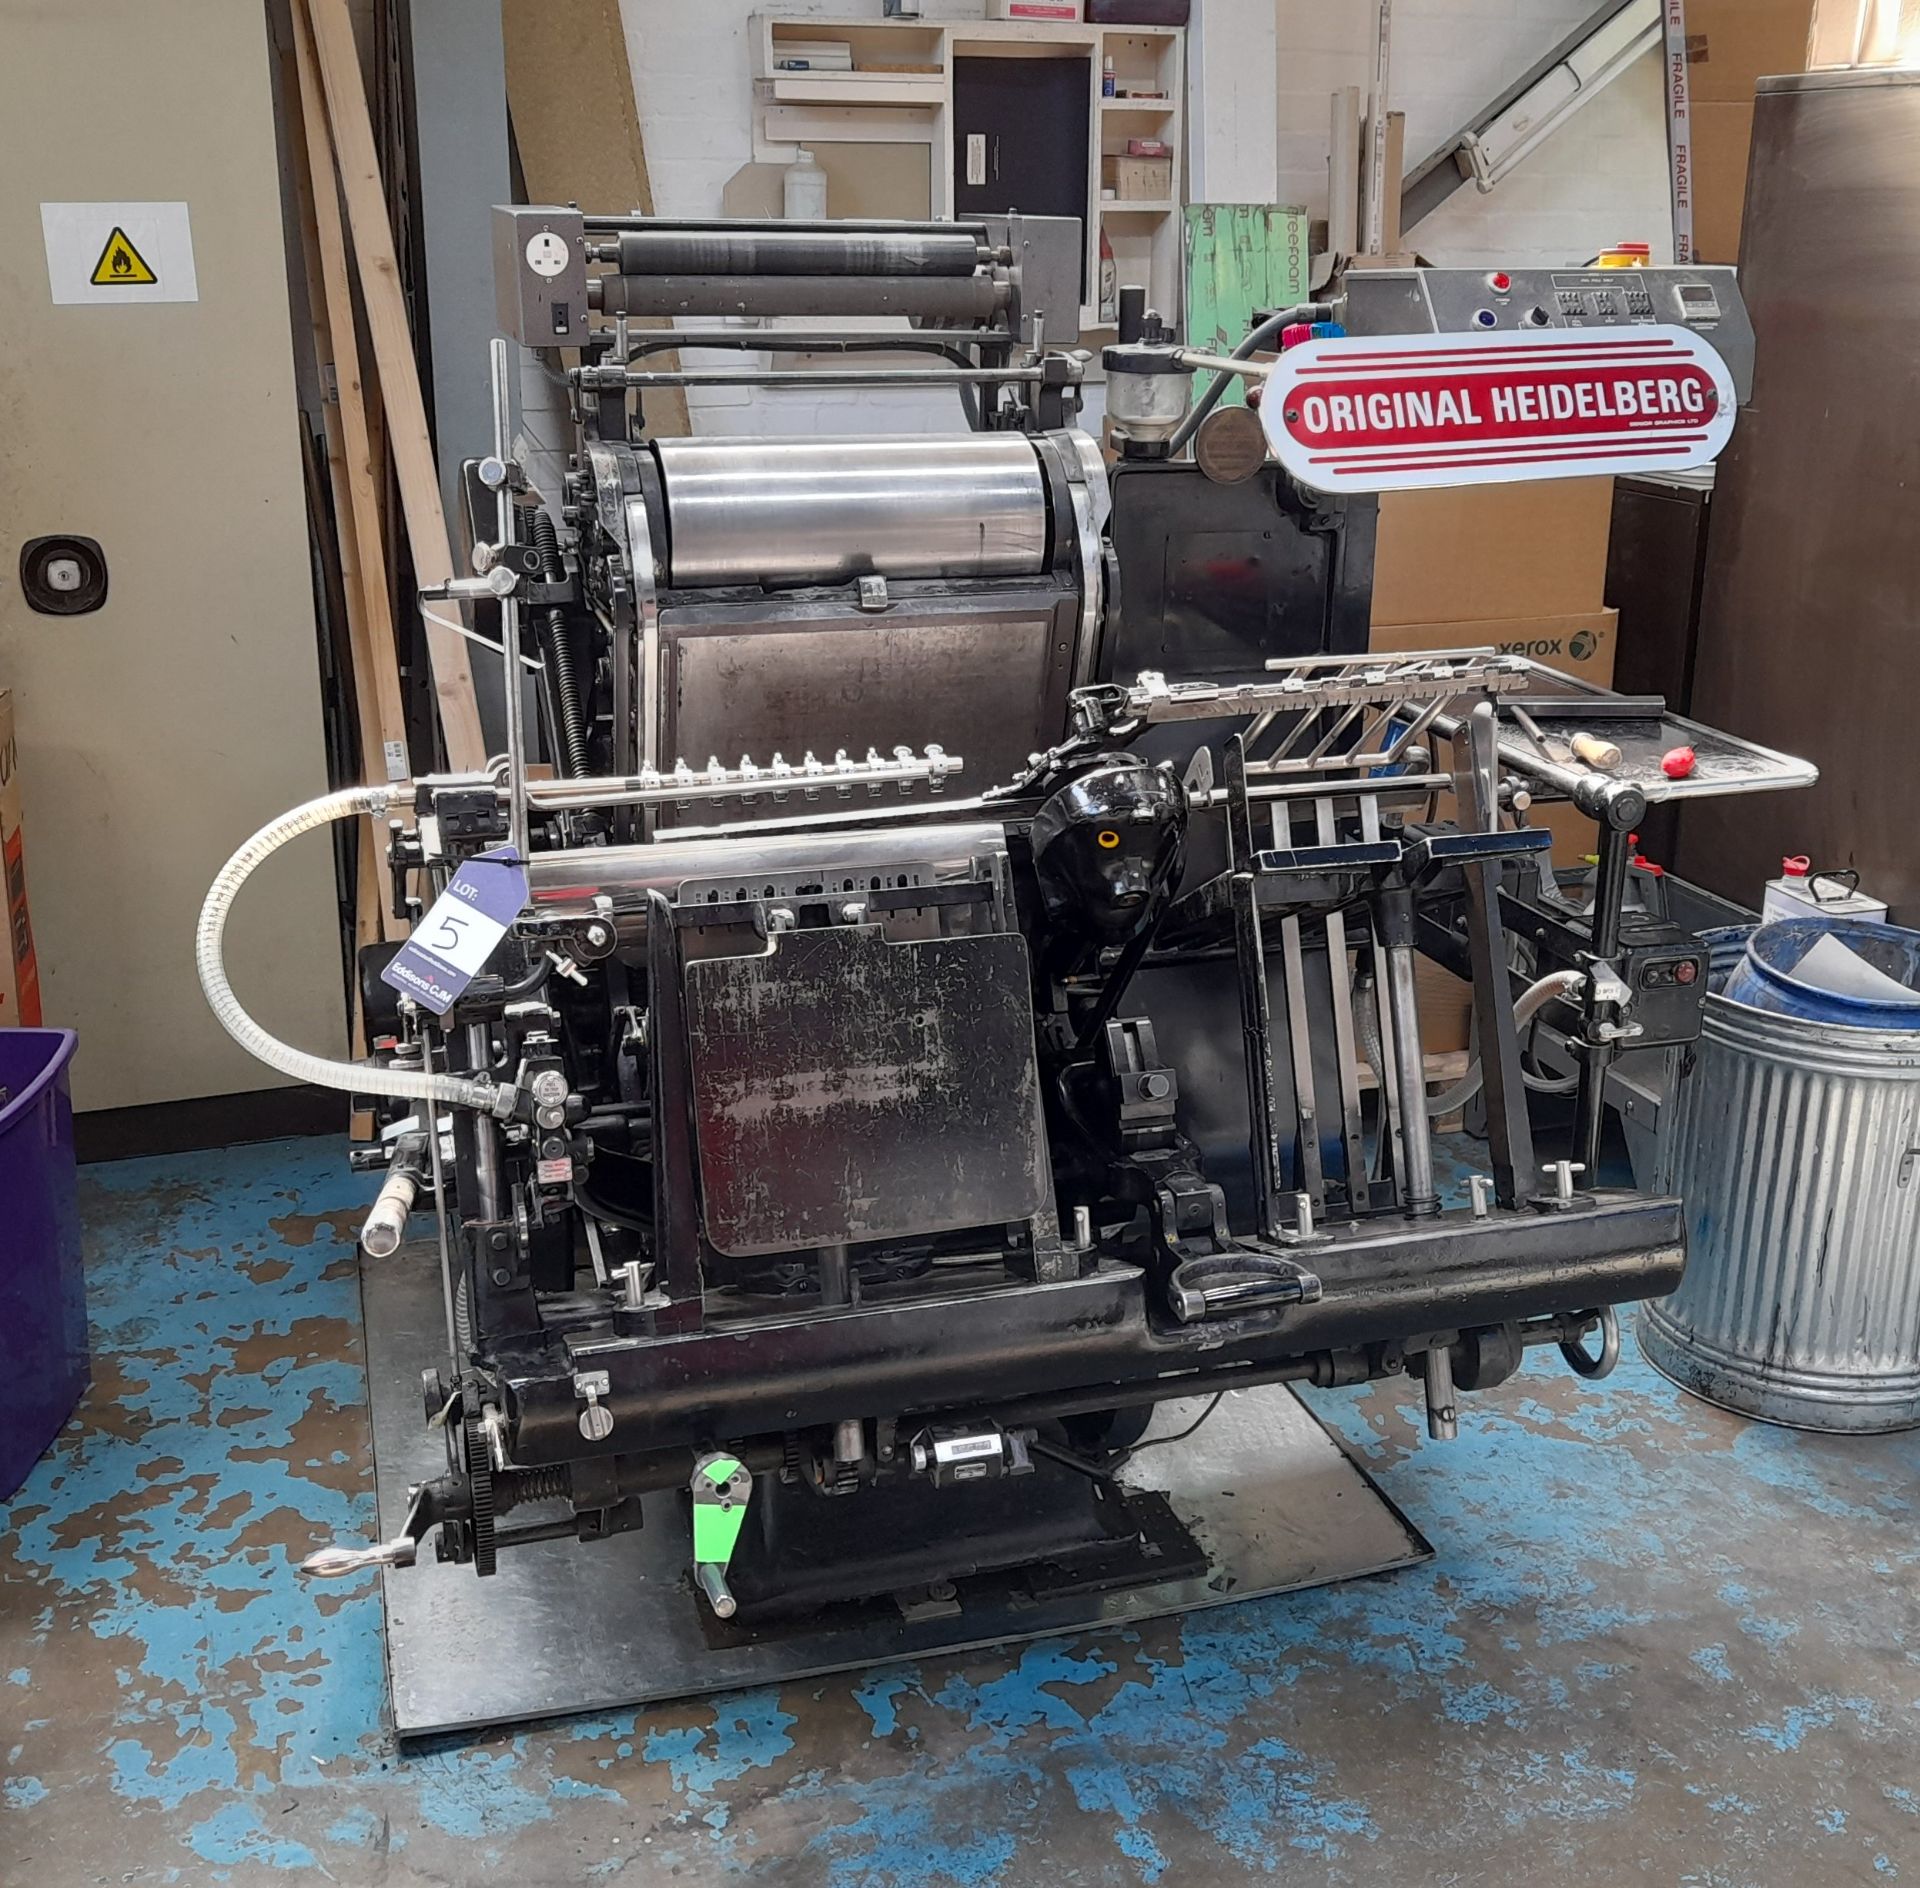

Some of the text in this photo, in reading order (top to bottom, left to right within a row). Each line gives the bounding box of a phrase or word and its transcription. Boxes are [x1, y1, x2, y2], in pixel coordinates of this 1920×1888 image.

[1670, 0, 1680, 25] ILE
[1672, 52, 1685, 119] FRAGILE
[1676, 144, 1688, 209] FRAGILE
[1679, 233, 1689, 264] FRA
[1302, 377, 1701, 434] ORIGINAL HEIDELBERG
[1500, 639, 1562, 656] xerox
[453, 879, 479, 901] LOT:
[432, 916, 469, 950] 5
[391, 961, 431, 991] Eddisons
[429, 984, 453, 1003] CJM
